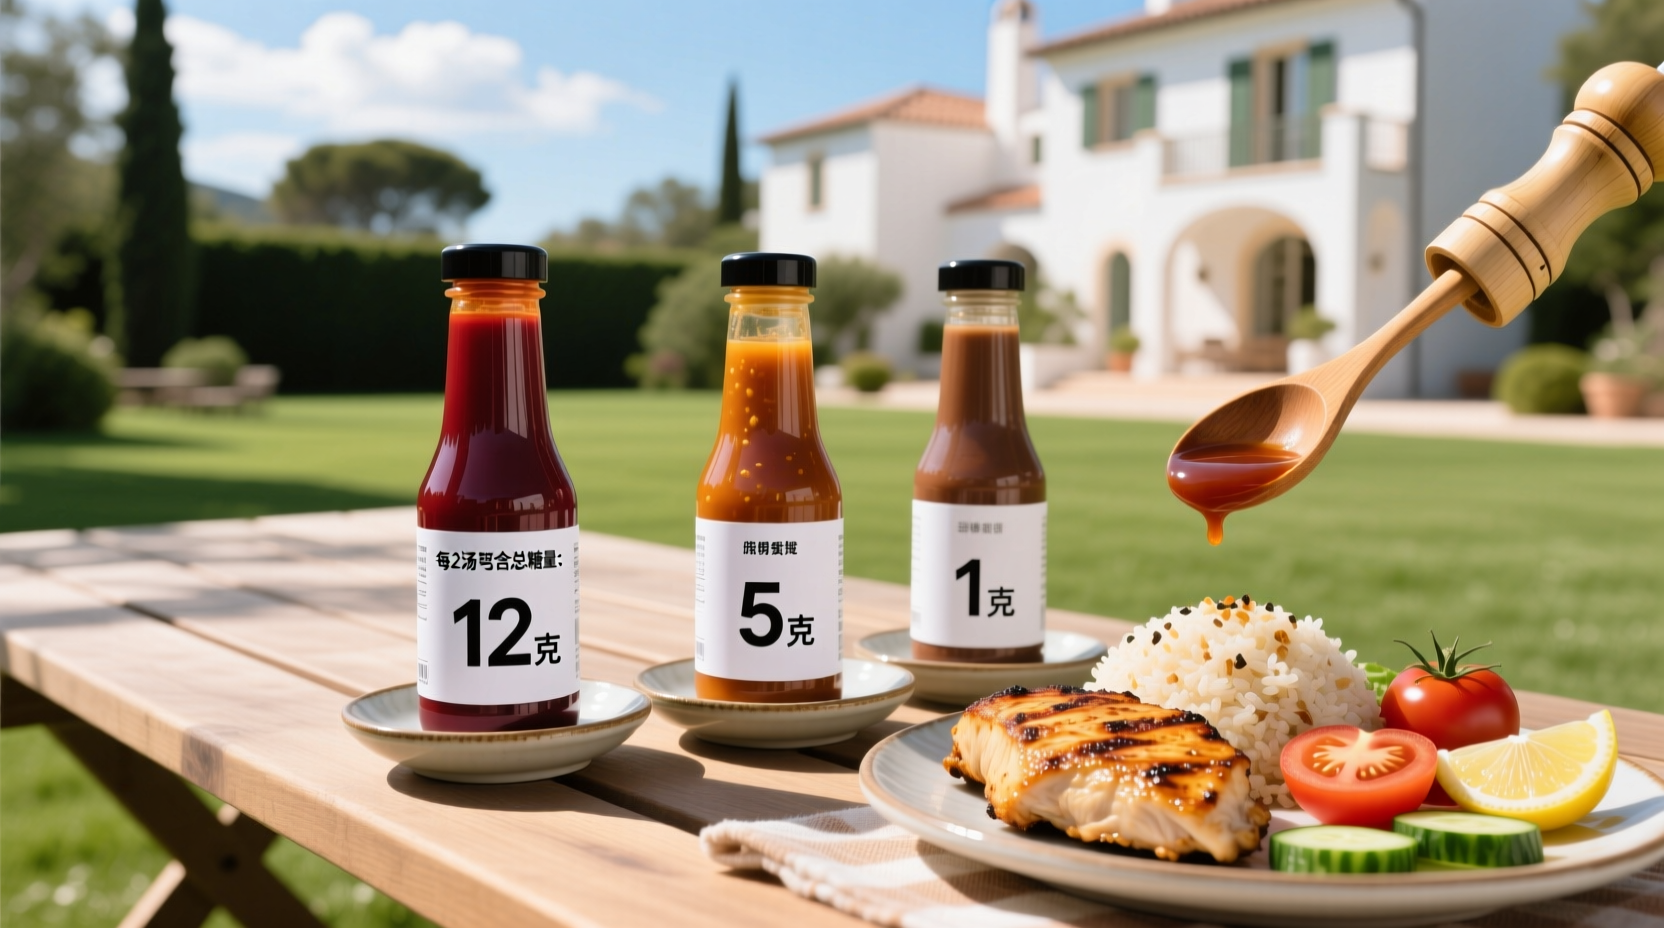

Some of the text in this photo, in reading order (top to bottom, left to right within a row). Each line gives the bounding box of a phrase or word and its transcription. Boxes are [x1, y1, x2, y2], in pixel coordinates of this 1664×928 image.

[738, 581, 815, 648] 5克
[955, 558, 1015, 618] 1克
[452, 597, 562, 668] 12克
